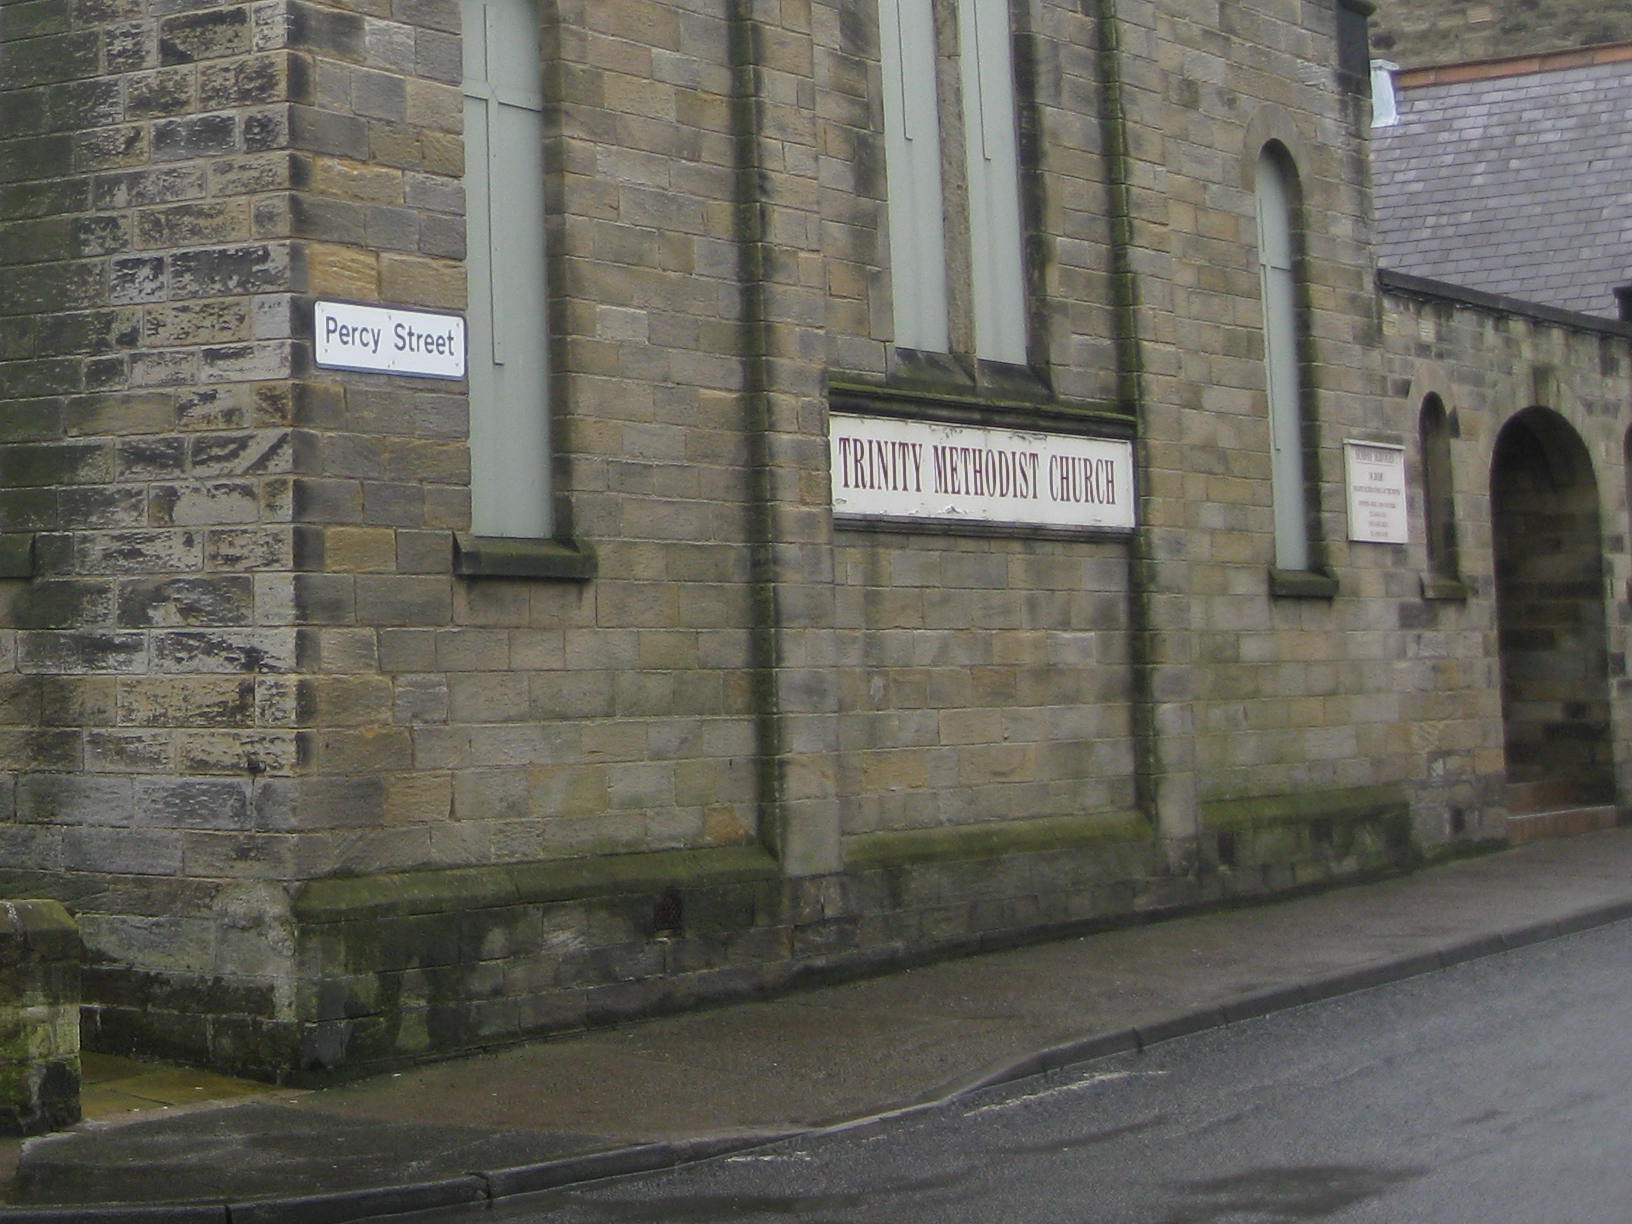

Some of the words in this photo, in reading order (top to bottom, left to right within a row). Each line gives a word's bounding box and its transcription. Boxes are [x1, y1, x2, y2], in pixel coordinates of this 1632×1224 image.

[326, 316, 381, 354] Percy
[394, 323, 455, 356] Street
[838, 437, 922, 493] TRINITY
[933, 445, 1039, 500] METHODIST
[1050, 454, 1116, 505] CHURCH
